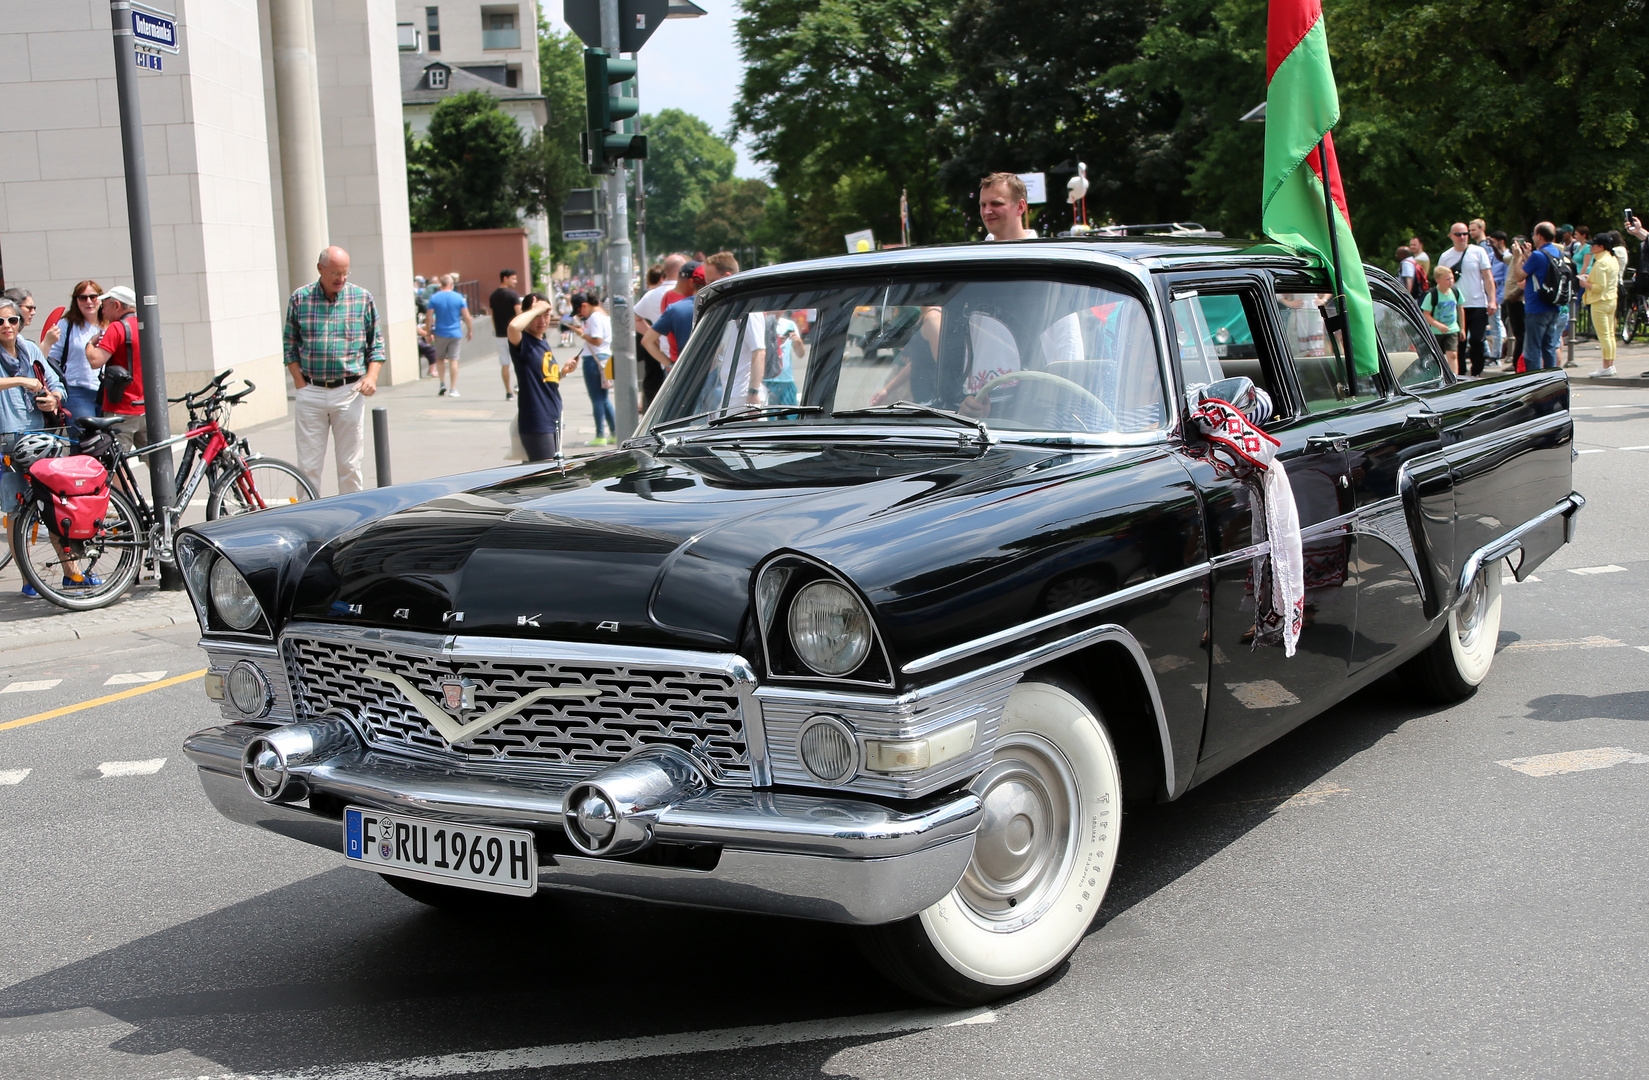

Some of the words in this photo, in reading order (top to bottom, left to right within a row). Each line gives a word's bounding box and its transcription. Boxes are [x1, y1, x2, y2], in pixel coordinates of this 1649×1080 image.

[135, 14, 173, 42] Untermainkai
[351, 839, 358, 851] D
[363, 817, 377, 854] F
